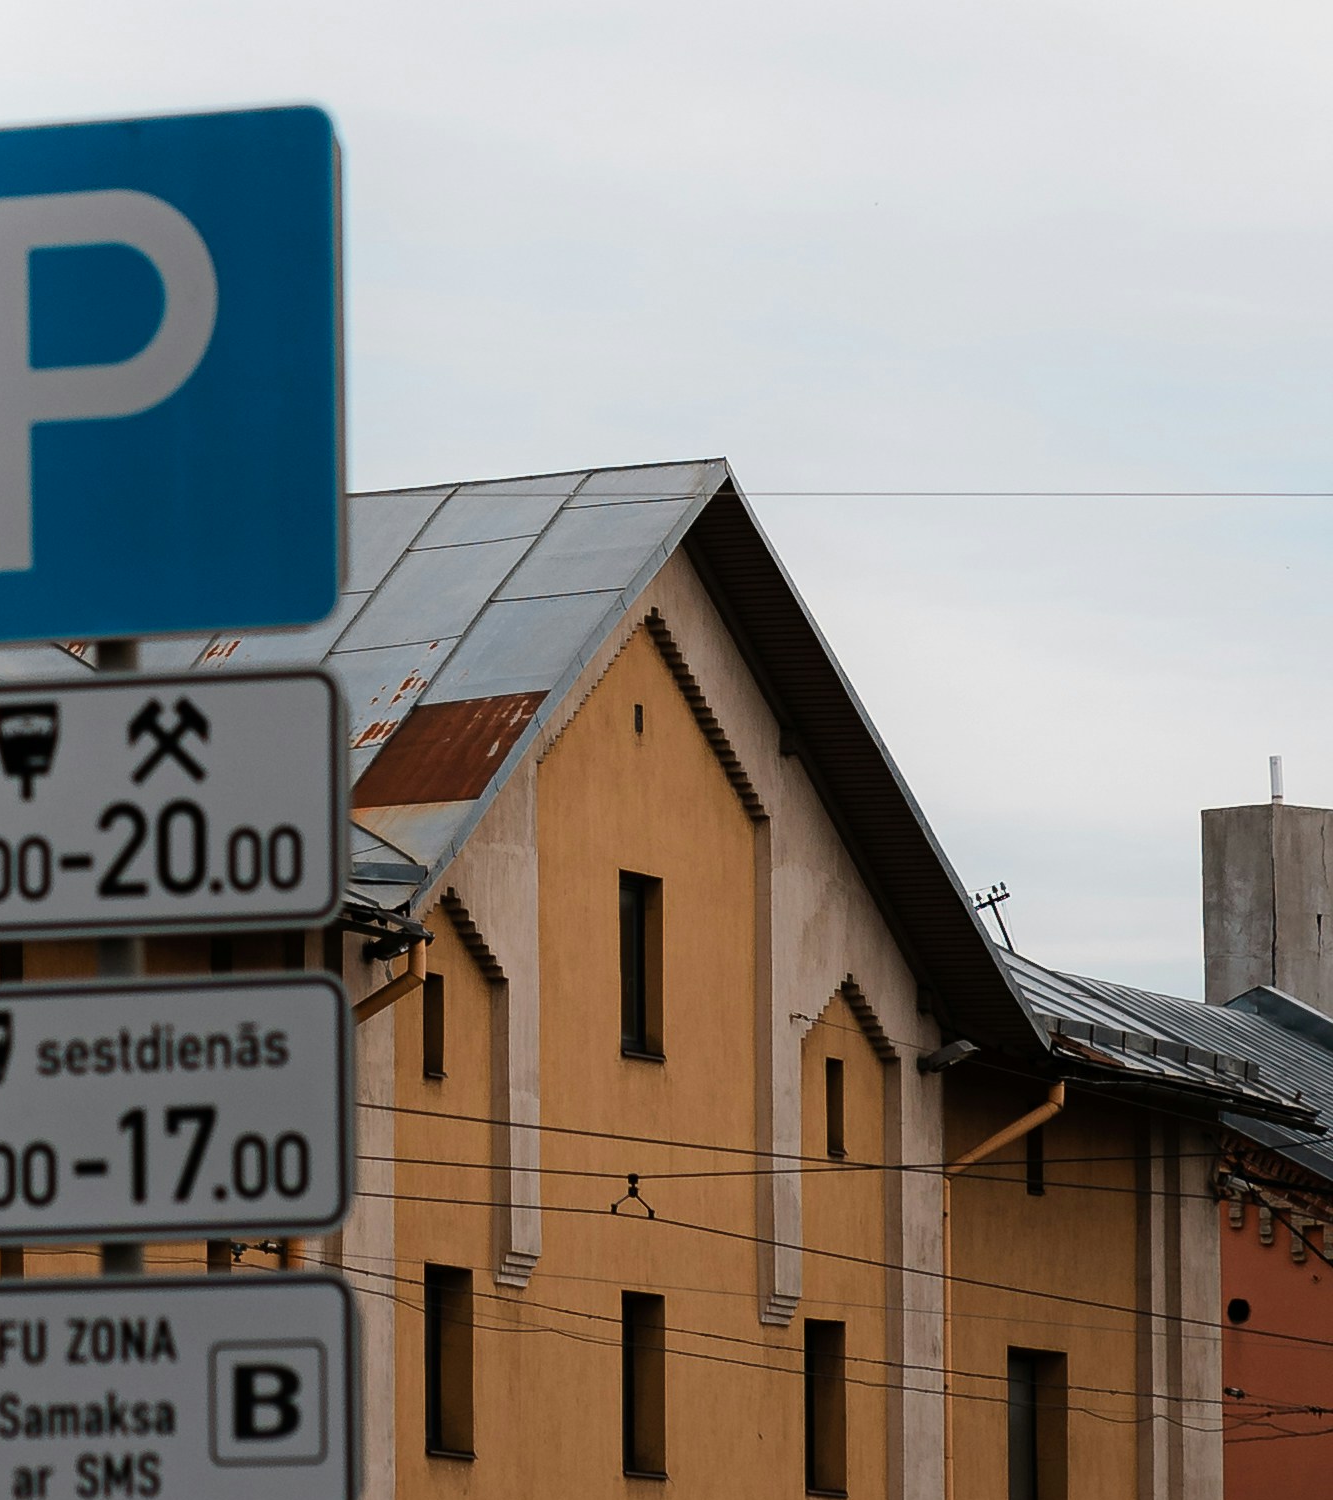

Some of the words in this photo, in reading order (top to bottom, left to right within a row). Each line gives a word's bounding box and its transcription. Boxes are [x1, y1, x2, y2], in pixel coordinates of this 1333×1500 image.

[37, 1022, 290, 1076] sestdienās
[66, 1317, 177, 1364] ZONA
[232, 1364, 300, 1442] B
[12, 1465, 51, 1500] ar
[76, 1453, 162, 1500] SMS
